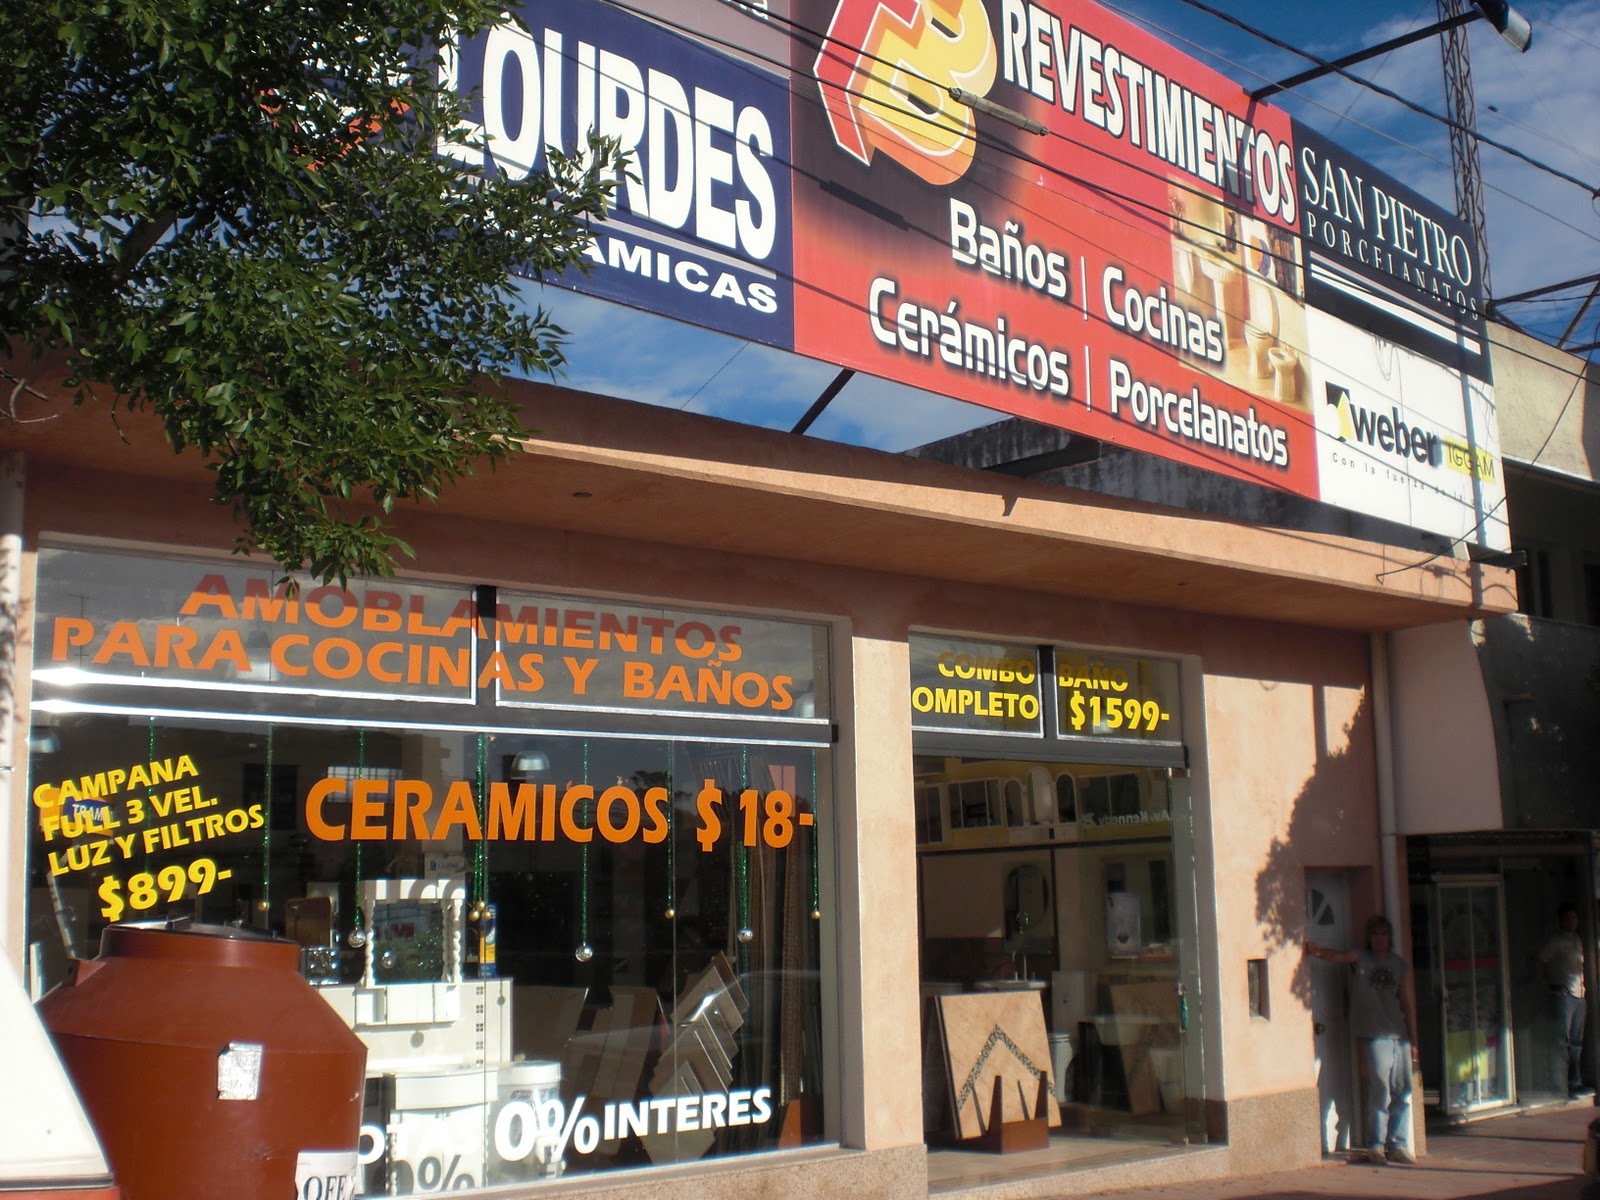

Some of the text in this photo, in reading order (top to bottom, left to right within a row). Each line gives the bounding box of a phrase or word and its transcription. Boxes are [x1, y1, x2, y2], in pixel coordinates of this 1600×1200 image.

[437, 10, 776, 260] LOURDES
[1001, 0, 1297, 226] REVESTIMIENTOS
[1302, 147, 1473, 287] SAN PIETRO
[950, 198, 1224, 363] Baños Cocinas
[1306, 211, 1480, 321] PORCELANATOS
[869, 278, 1288, 466] Cerámicos Porcelanatos
[1332, 453, 1355, 469] Con
[1350, 403, 1440, 468] weber
[180, 573, 742, 662] AMOBLAMIENTOS
[51, 617, 794, 711] PARA COCINAS Y BAÑOS
[937, 651, 1036, 685] COMBO
[911, 686, 1170, 731] OMPLETO $1599-
[33, 754, 199, 809] CAMPANA
[42, 785, 218, 842] FULL 3 VEL.
[305, 777, 670, 844] CERAMICOS
[48, 804, 265, 877] LUZ Y FILTROS
[97, 858, 232, 922] $899-
[603, 1088, 772, 1141] INTERES
